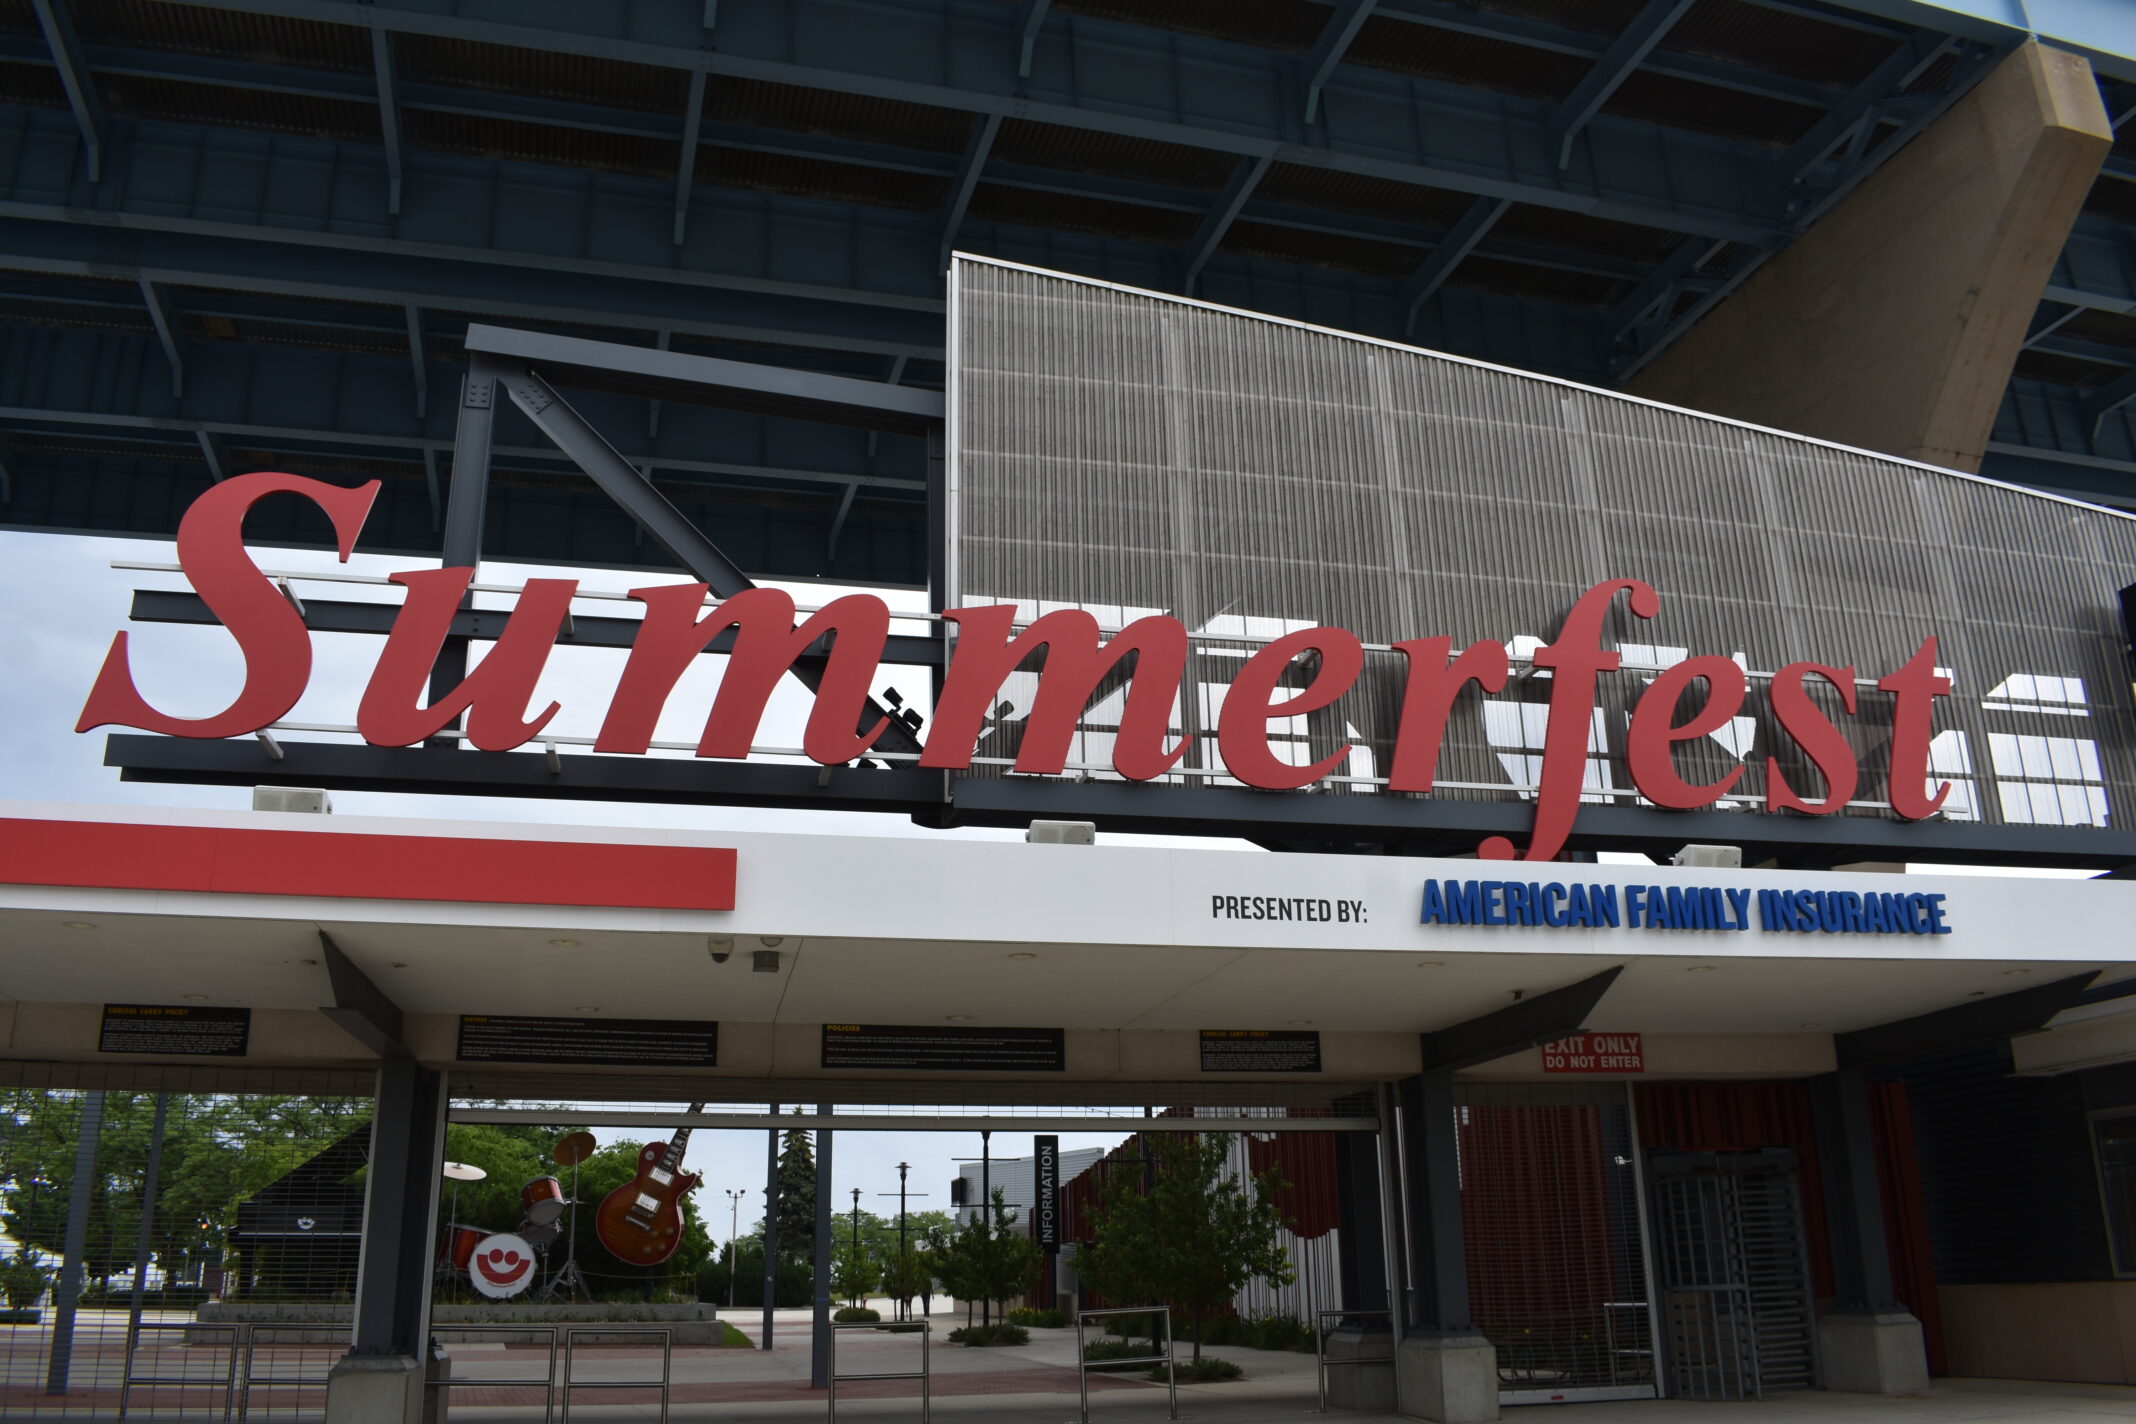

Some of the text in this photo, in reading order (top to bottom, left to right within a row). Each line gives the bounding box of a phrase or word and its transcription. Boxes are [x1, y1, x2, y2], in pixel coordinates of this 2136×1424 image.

[75, 472, 1951, 862] Summerfest
[1212, 895, 1368, 923] PRESENTED BY:
[1420, 879, 1952, 935] AMERICAN FAMILY INSURANCE
[165, 1008, 189, 1016] POLICY
[1544, 1036, 1640, 1054] EXIT ONLY
[1546, 1056, 1641, 1068] DO NOT ENTER
[1041, 1146, 1054, 1243] INFORMATION
